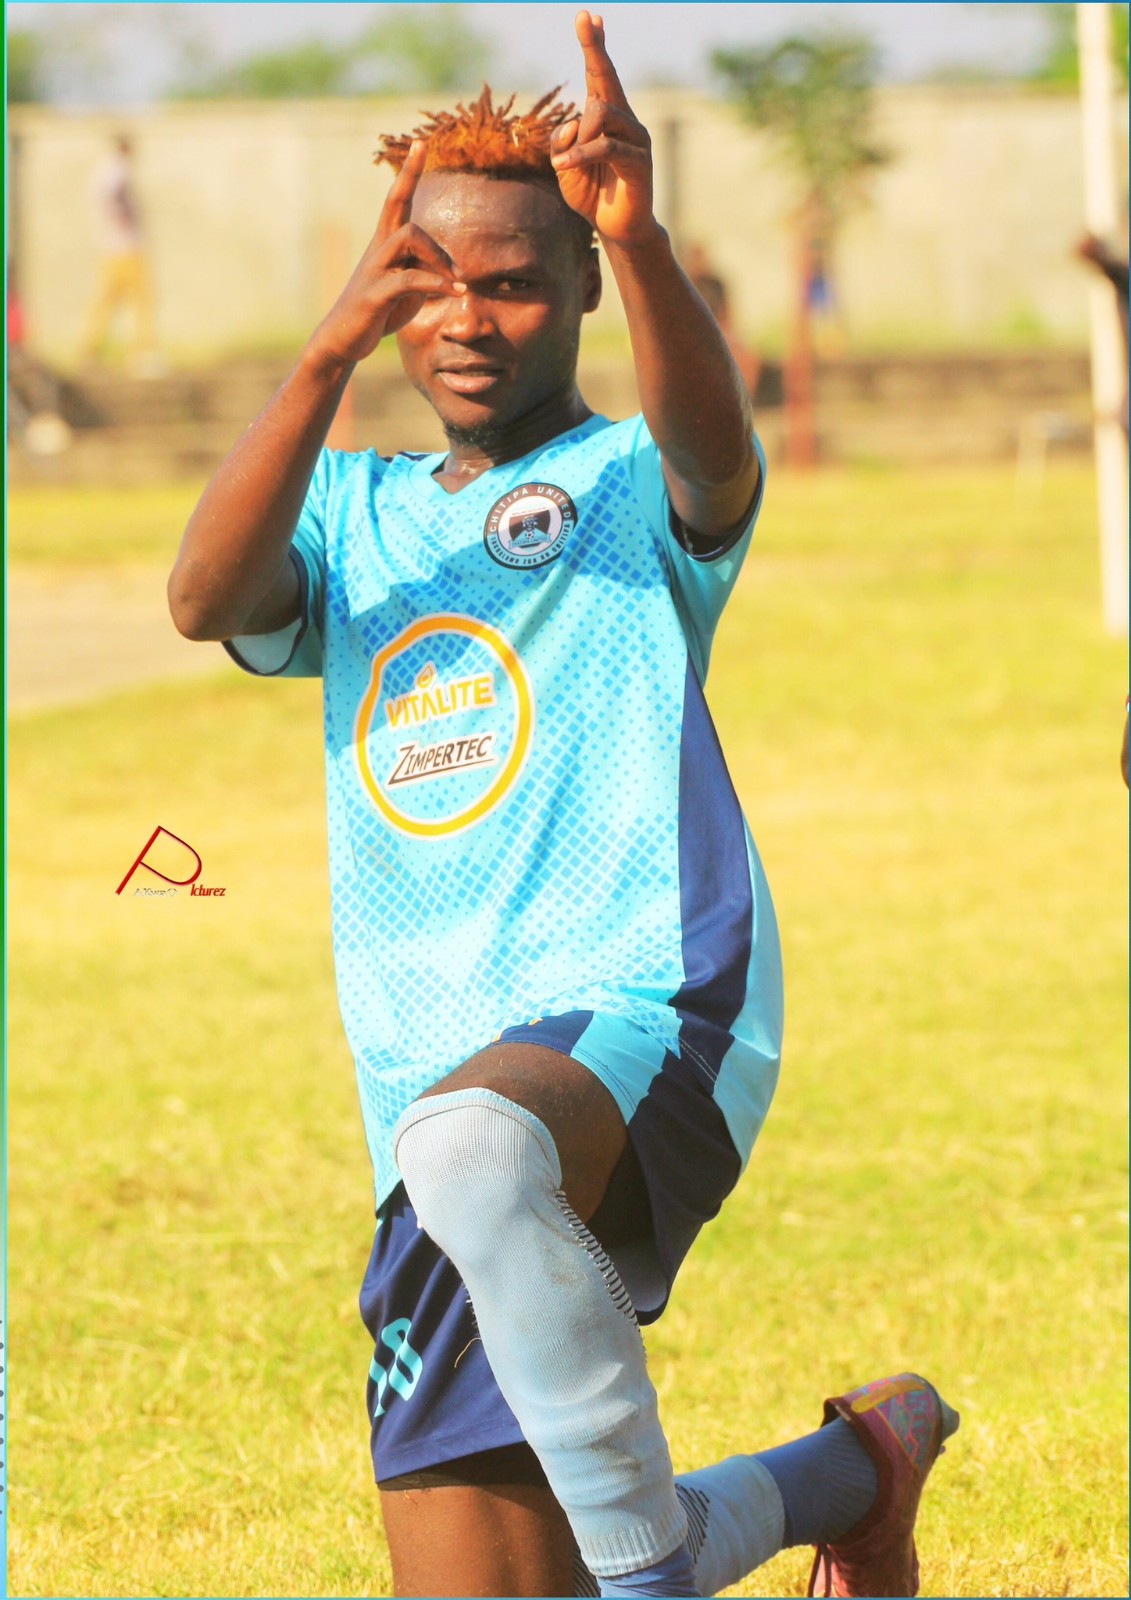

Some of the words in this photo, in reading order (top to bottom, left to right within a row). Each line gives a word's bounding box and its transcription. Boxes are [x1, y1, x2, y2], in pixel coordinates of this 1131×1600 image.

[490, 487, 529, 533] CHITIPA
[537, 486, 571, 518] UNITED
[551, 523, 571, 552] CHITIPA
[387, 676, 493, 728] VITALITE
[388, 735, 495, 785] ZIMPERTEC
